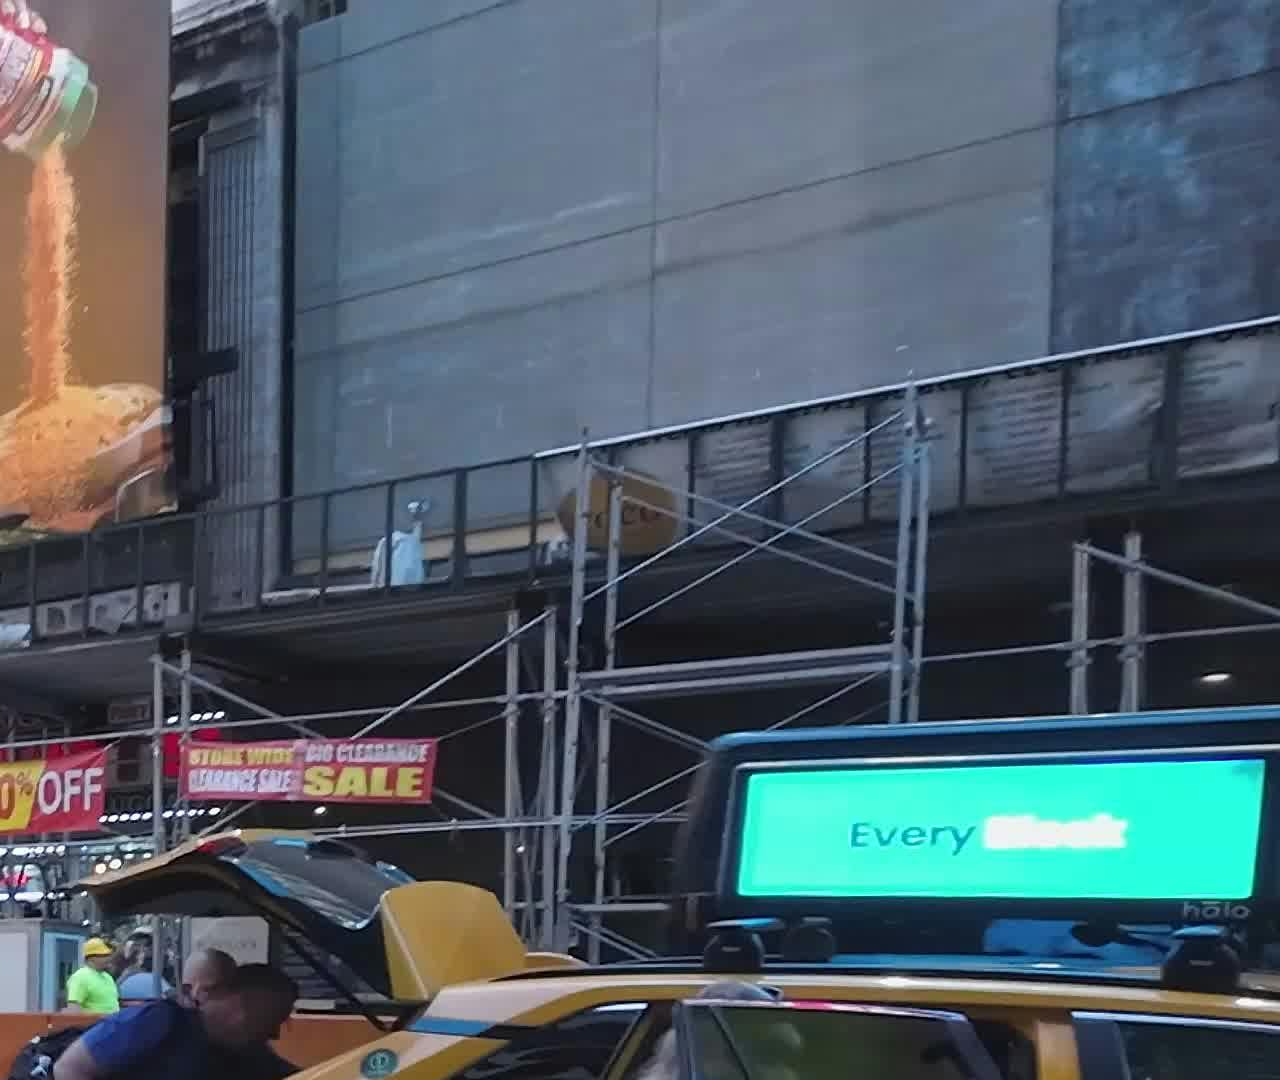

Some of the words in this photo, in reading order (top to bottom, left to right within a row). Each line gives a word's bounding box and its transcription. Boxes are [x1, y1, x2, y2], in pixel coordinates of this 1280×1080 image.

[37, 767, 105, 815] OFF
[303, 766, 425, 798] SALE
[850, 821, 976, 857] Every
